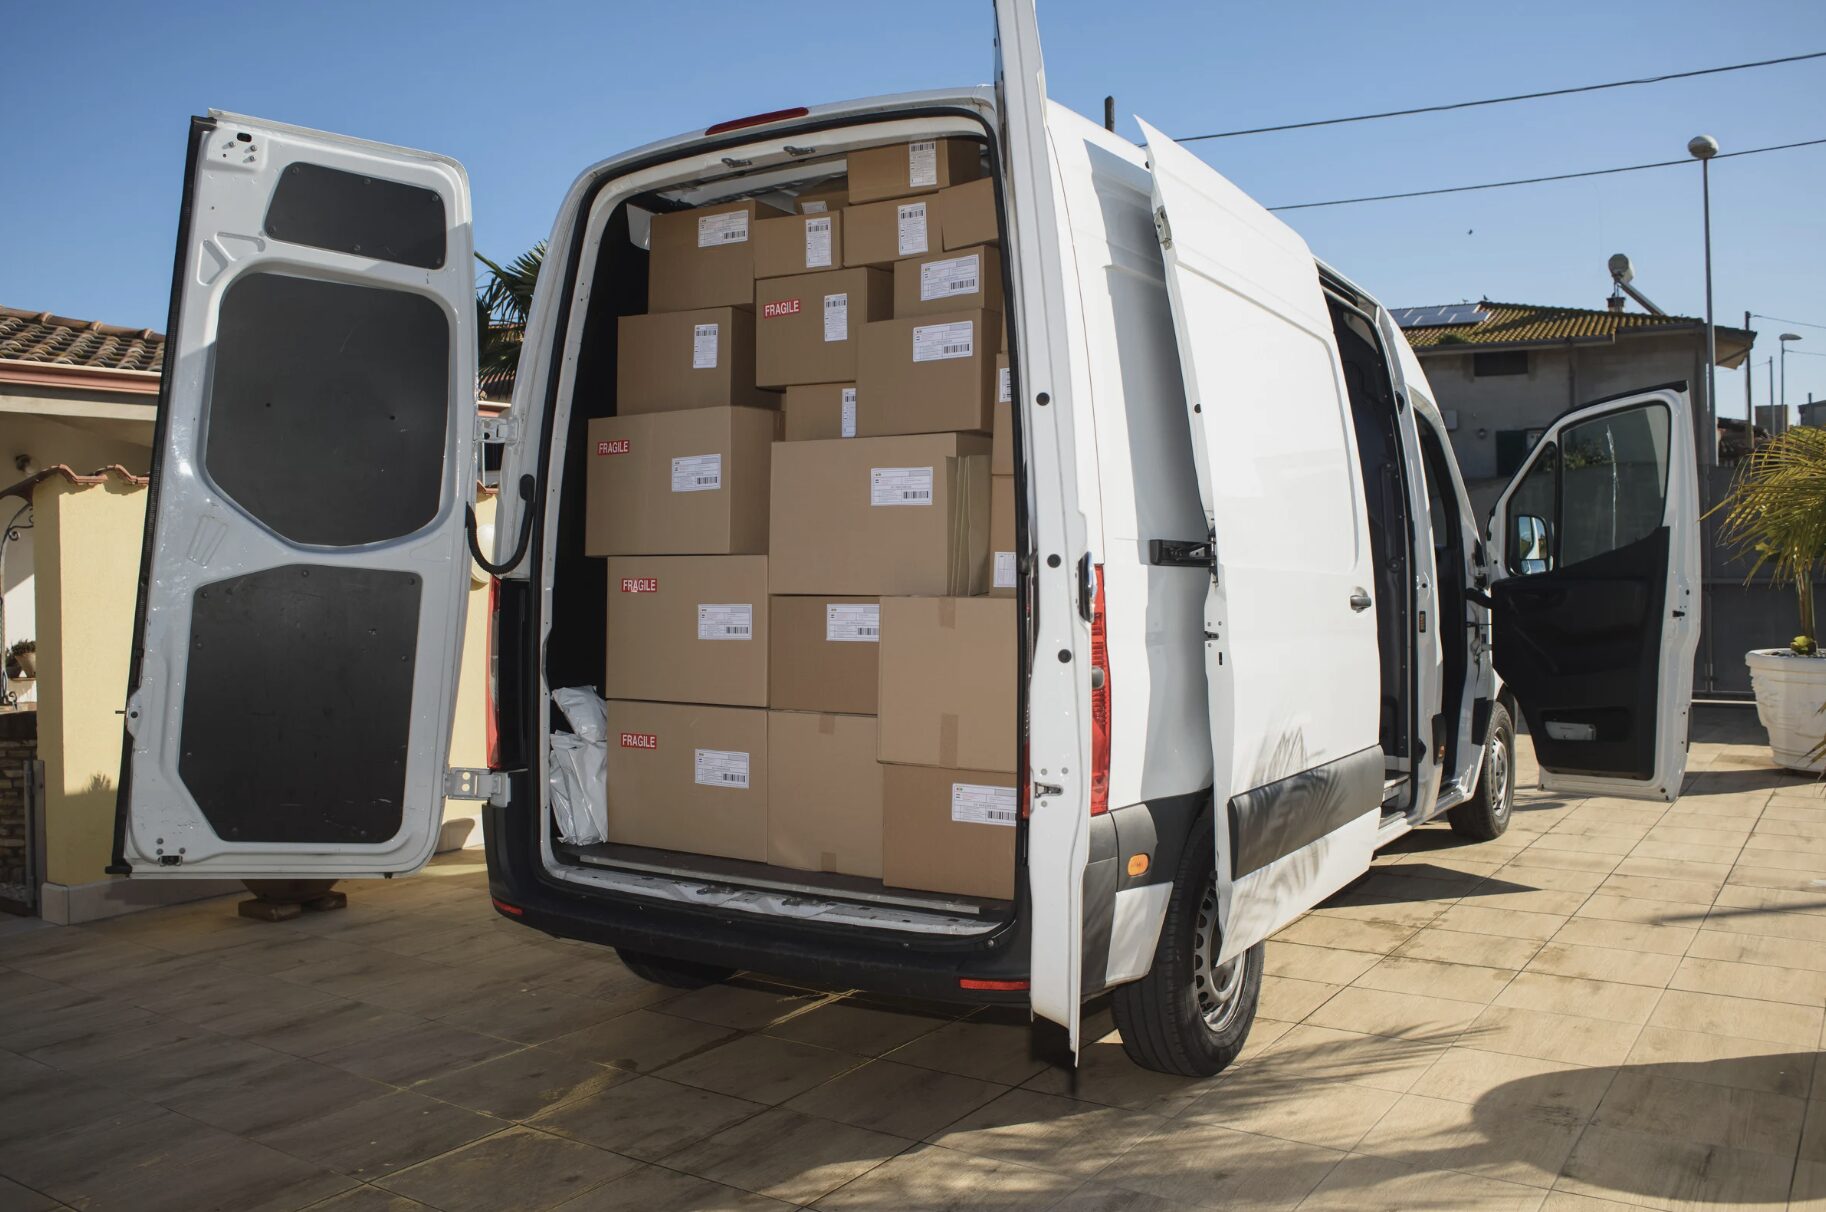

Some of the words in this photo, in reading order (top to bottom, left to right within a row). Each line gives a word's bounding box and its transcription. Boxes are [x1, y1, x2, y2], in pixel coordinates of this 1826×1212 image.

[765, 300, 799, 317] FRAGILE
[598, 441, 629, 454] FRAGILE
[623, 579, 656, 591] FRAGILE
[622, 734, 655, 748] FRAGILE
